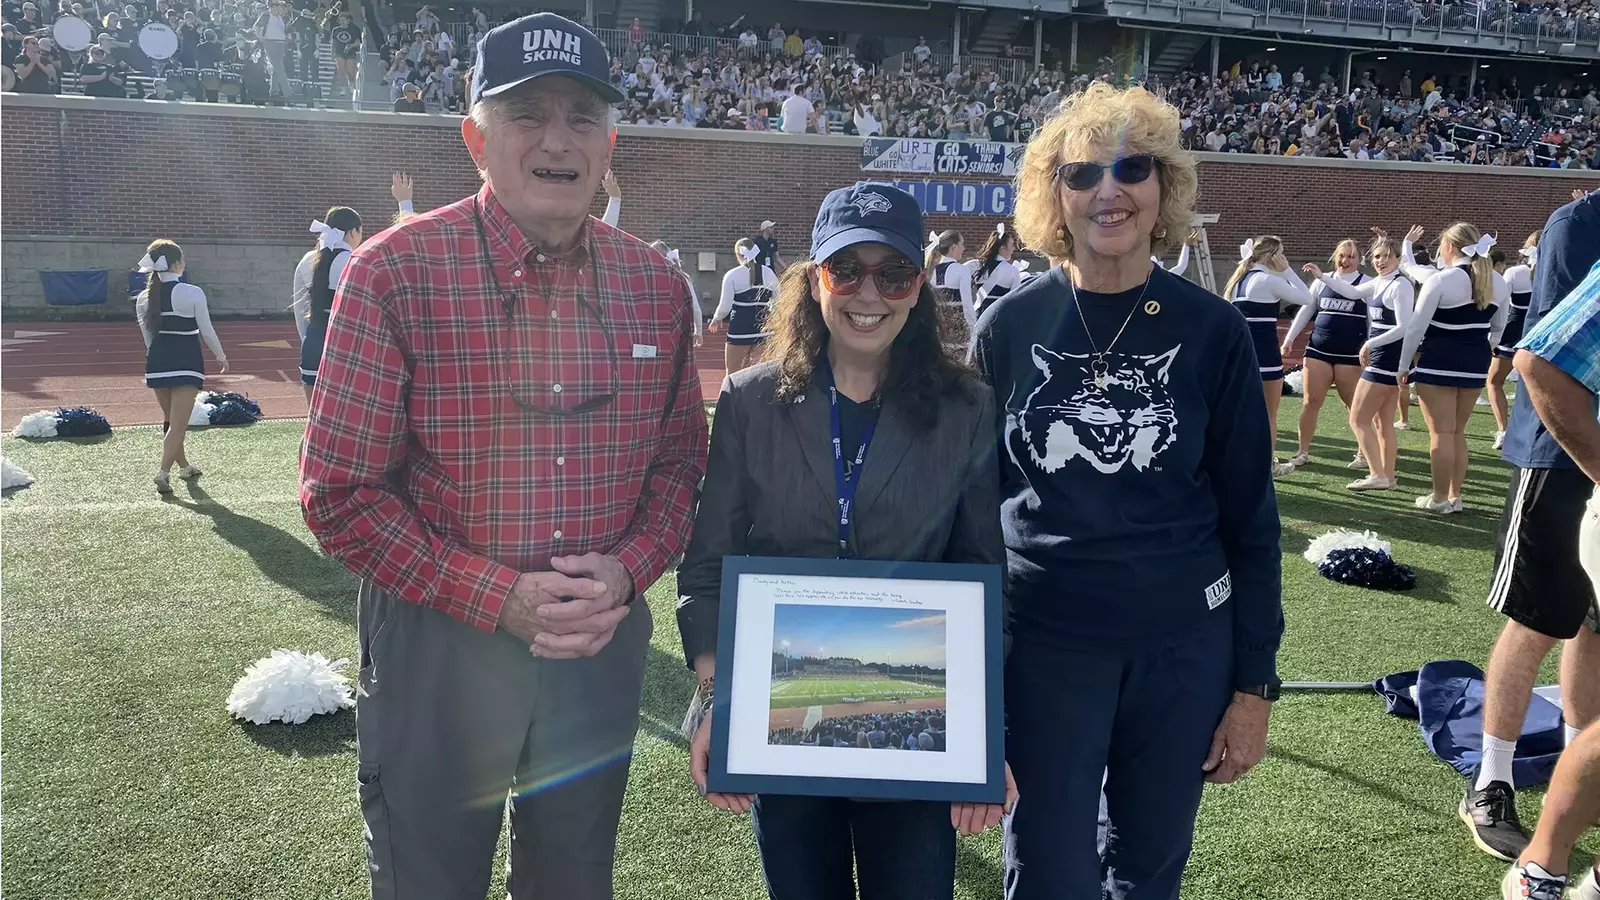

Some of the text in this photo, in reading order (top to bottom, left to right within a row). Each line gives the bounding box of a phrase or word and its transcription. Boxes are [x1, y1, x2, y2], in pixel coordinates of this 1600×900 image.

[523, 29, 581, 55] UNH
[523, 50, 581, 66] SKIING
[863, 146, 880, 157] BLUE
[901, 141, 932, 154] URI
[943, 142, 960, 156] GO
[975, 144, 1001, 154] THANK
[889, 151, 898, 159] GO
[980, 154, 994, 162] YOU
[873, 160, 897, 169] WHITE
[969, 161, 1003, 174] SENIORS!
[1320, 297, 1355, 312] UNH
